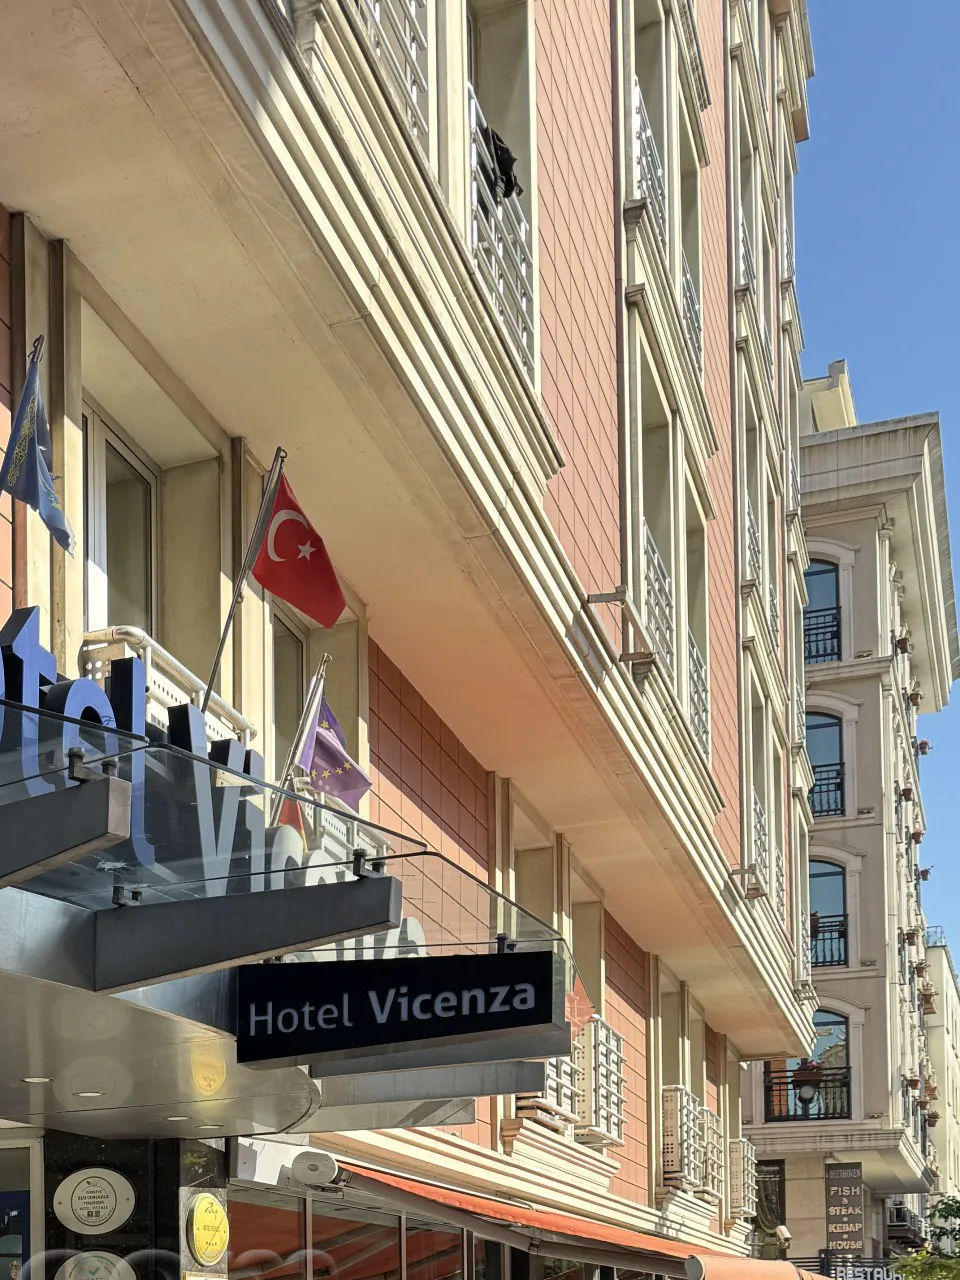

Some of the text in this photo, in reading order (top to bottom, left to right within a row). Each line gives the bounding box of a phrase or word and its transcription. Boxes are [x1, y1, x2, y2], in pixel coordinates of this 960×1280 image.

[249, 981, 536, 1037] Hotel Vicenza
[829, 1186, 860, 1196] FISH
[828, 1206, 862, 1216] STEAK
[828, 1223, 862, 1233] KEBAP
